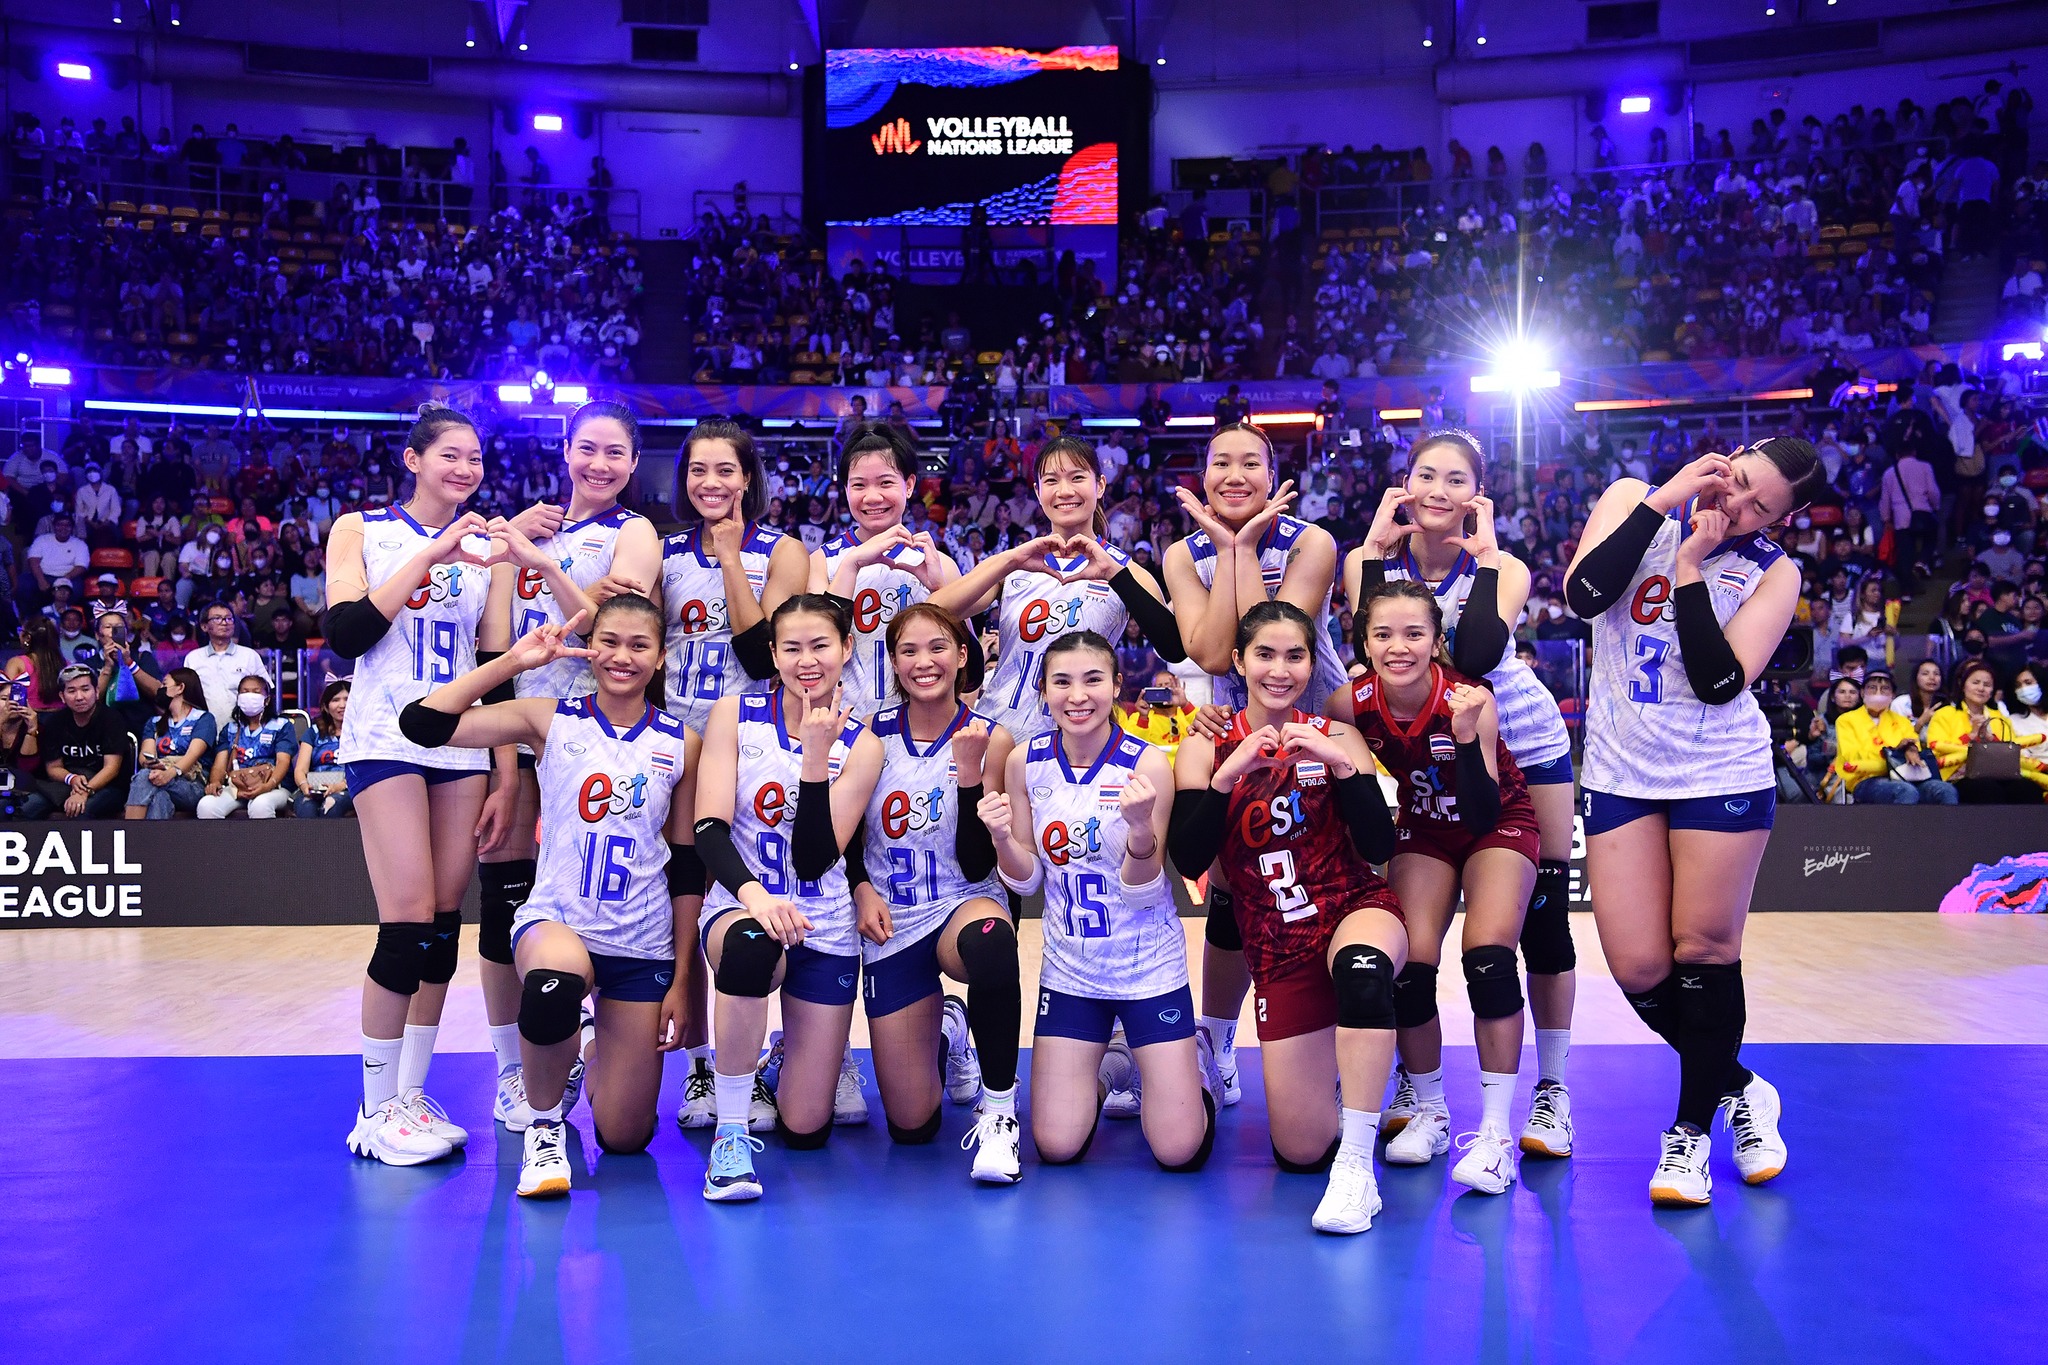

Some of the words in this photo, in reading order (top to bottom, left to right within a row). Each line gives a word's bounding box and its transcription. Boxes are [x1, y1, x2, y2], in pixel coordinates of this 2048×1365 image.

[926, 116, 1073, 138] VOLLEYBALL
[927, 139, 1001, 155] NATIONS
[1007, 138, 1073, 154] LEAGUE
[680, 597, 731, 634] es
[854, 584, 912, 633] est
[1085, 595, 1107, 603] THA
[1716, 585, 1740, 601] THA
[1019, 597, 1083, 643] est
[413, 617, 459, 683] 19
[676, 640, 729, 700] 18
[1628, 634, 1671, 704] 3
[1358, 686, 1373, 701] PEA
[1034, 739, 1050, 748] PEA
[1122, 743, 1138, 753] PEA
[579, 773, 648, 823] est
[651, 771, 671, 780] THA
[1297, 778, 1327, 788] THA
[754, 782, 800, 828] es
[882, 787, 945, 839] est
[1241, 789, 1306, 848] est
[1584, 793, 1592, 817] 3
[0, 830, 142, 875] BALL
[1042, 816, 1101, 865] est
[1290, 827, 1308, 841] COLA
[580, 832, 636, 901] 16
[887, 847, 938, 906] 21
[1259, 849, 1309, 912] 2
[1061, 873, 1111, 938] 15
[1258, 998, 1267, 1022] 2
